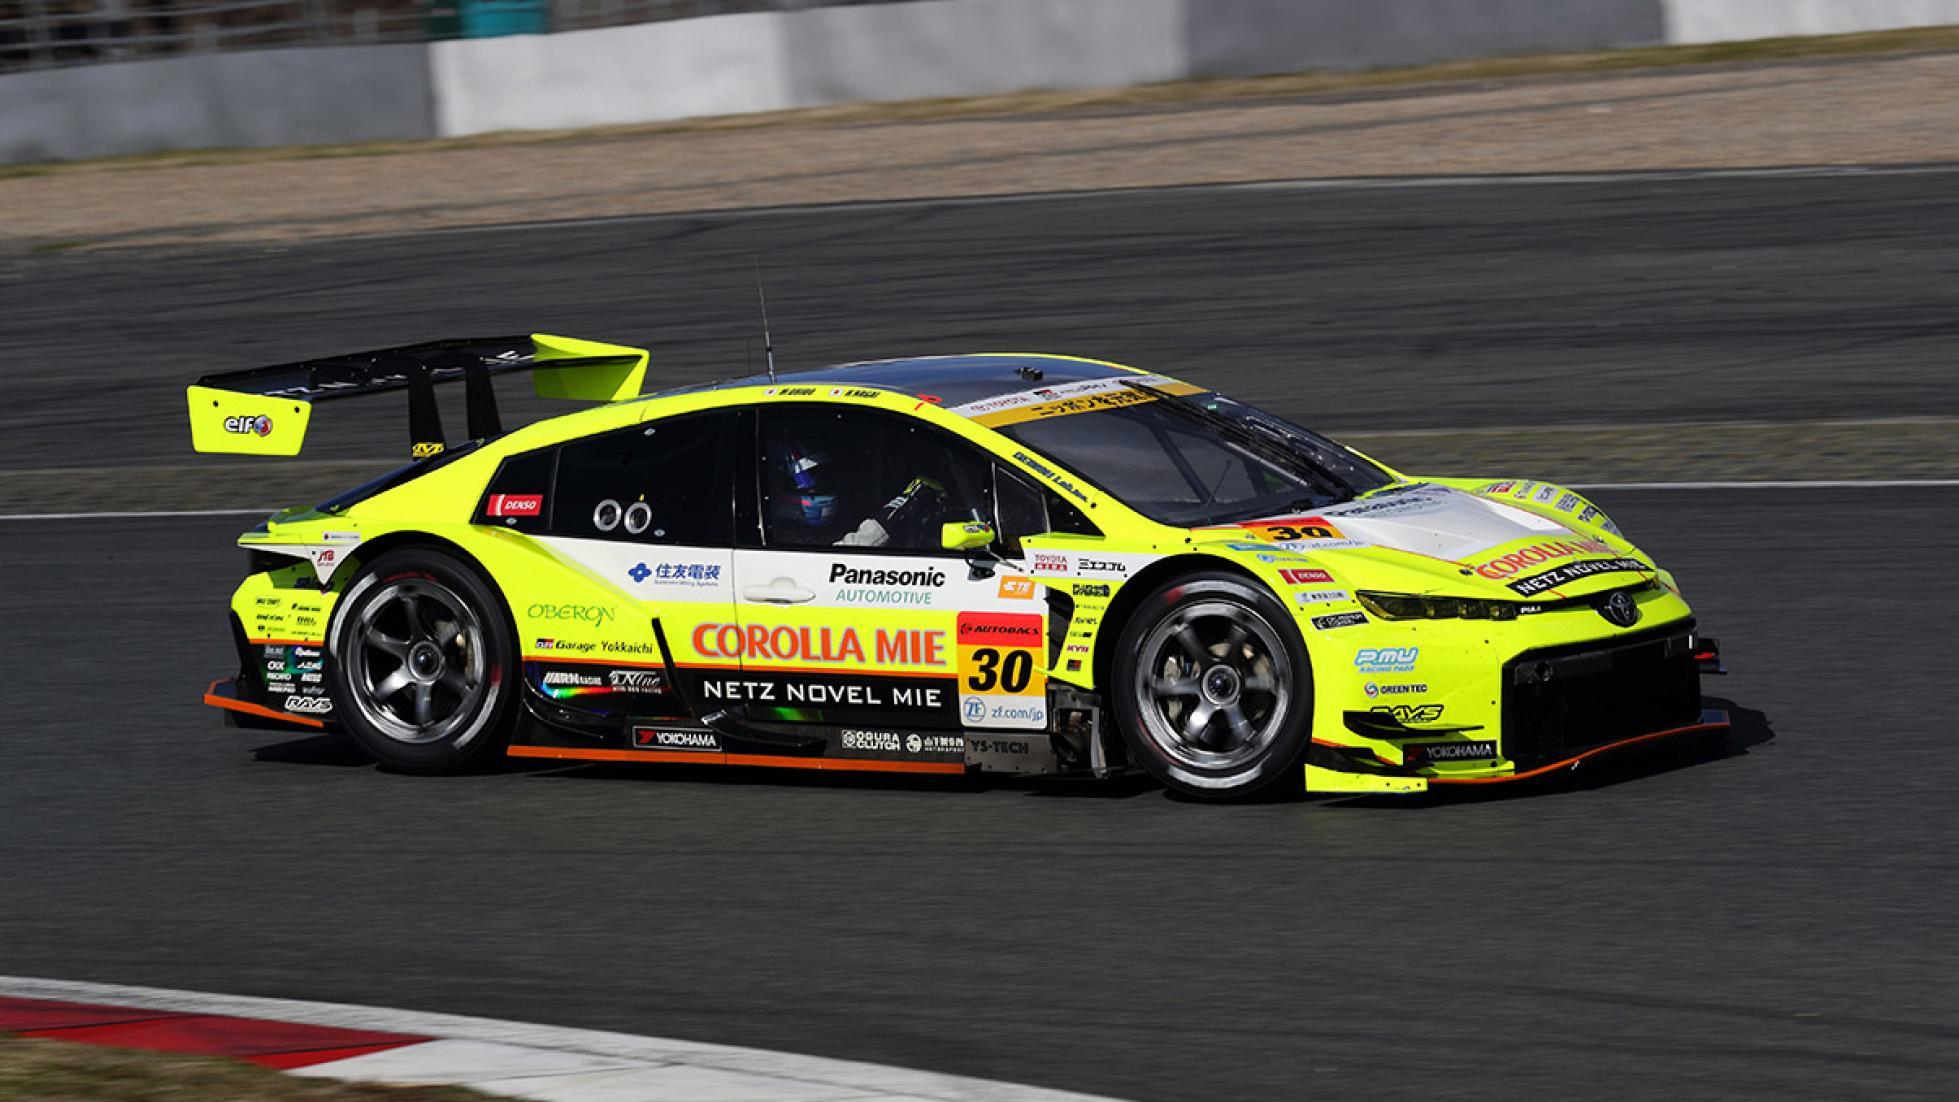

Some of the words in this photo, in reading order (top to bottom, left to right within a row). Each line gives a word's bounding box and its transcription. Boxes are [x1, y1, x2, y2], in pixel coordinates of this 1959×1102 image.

[224, 415, 255, 434] elf
[505, 501, 537, 510] DENSO
[1034, 554, 1067, 562] TOYOTA
[656, 563, 721, 580] 住友電装
[829, 563, 946, 587] Panasonic
[1516, 571, 1564, 593] NETZ
[835, 589, 932, 605] AUTOMOTIVE
[527, 604, 616, 628] OBERON
[556, 640, 596, 653] Garage
[601, 640, 653, 654] Yokkaichi
[692, 623, 866, 663] COROLLA
[875, 628, 947, 666] MIE
[969, 648, 1033, 693] 30
[703, 680, 775, 700] NETZ
[787, 683, 881, 705] NOVEL
[893, 687, 942, 708] MIE
[1380, 684, 1409, 694] GREEN
[992, 705, 1043, 722] zf.com/jp
[656, 731, 716, 747] YOKOHAMA
[971, 740, 1030, 754] YS-TECH
[1426, 744, 1492, 758] YOKOHAMA
